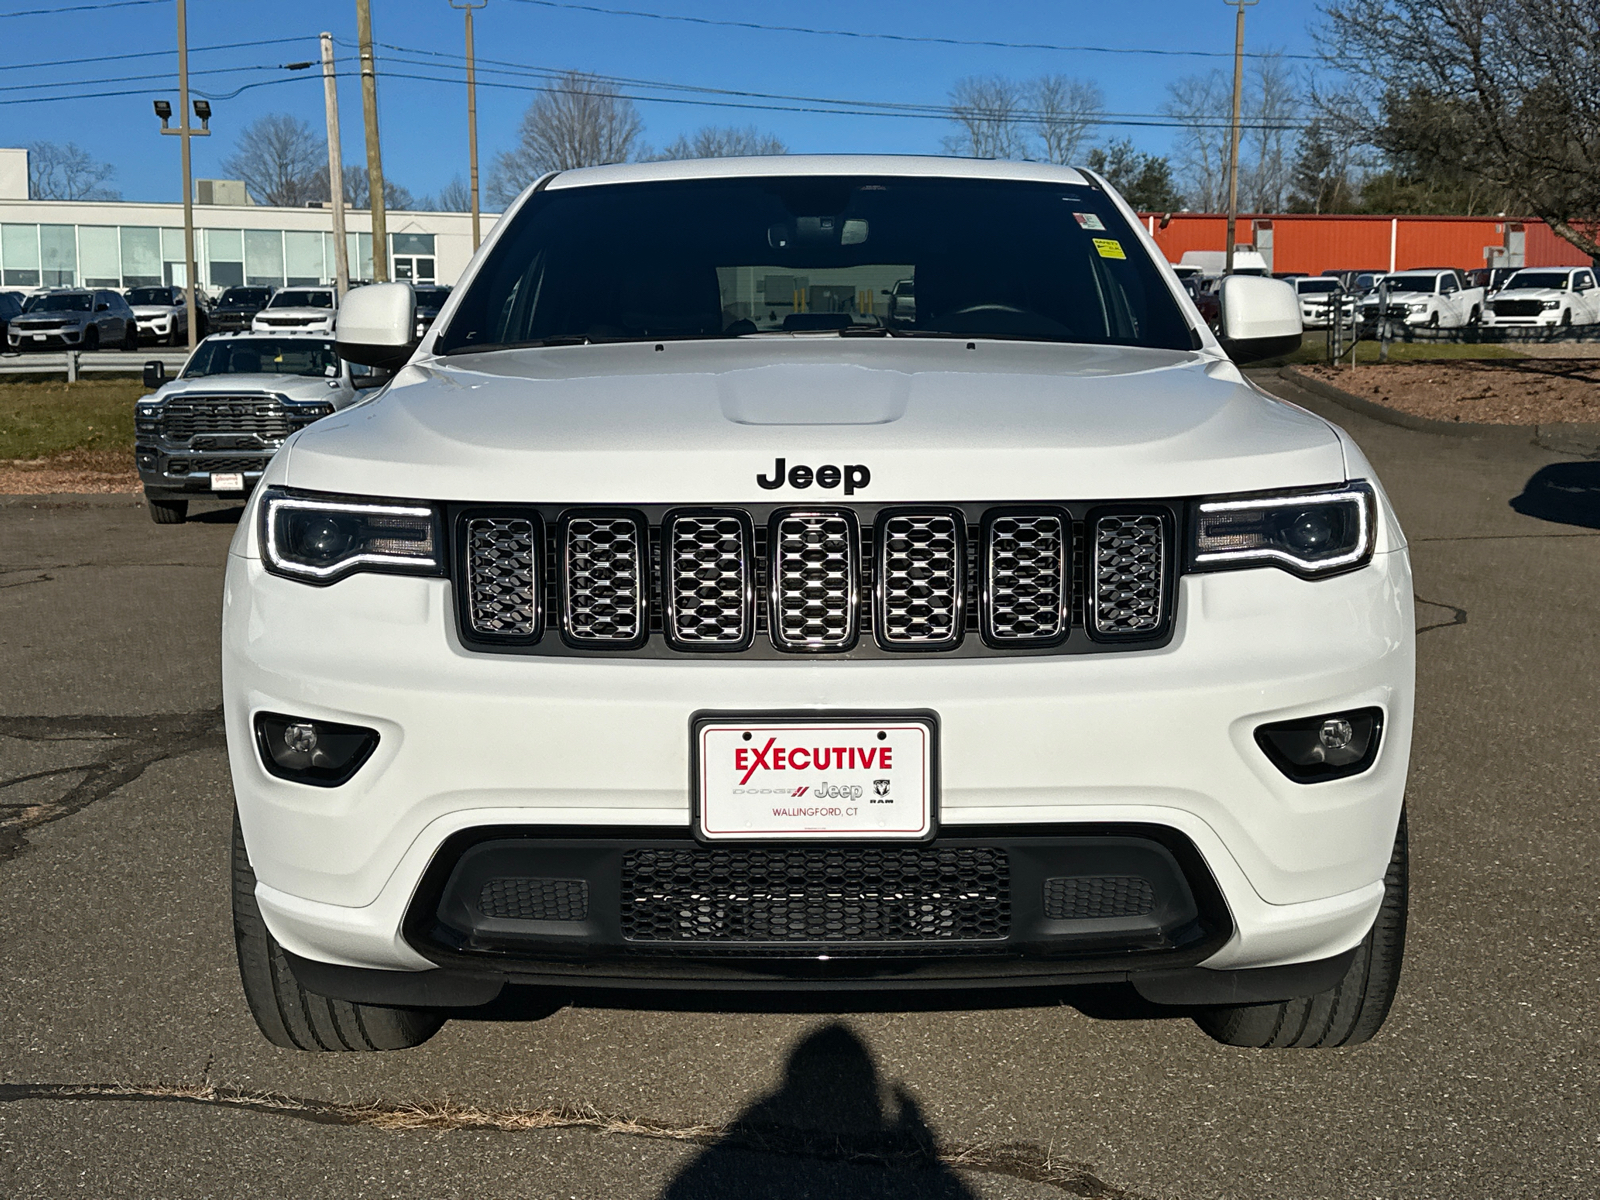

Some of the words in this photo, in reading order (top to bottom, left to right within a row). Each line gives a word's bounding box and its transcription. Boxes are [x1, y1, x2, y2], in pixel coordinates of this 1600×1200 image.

[756, 458, 871, 495] Jeep
[735, 737, 893, 785] EXECUTIVE
[814, 782, 863, 801] Jeep
[772, 808, 844, 817] WALLINGFORD,
[845, 807, 858, 816] CT
